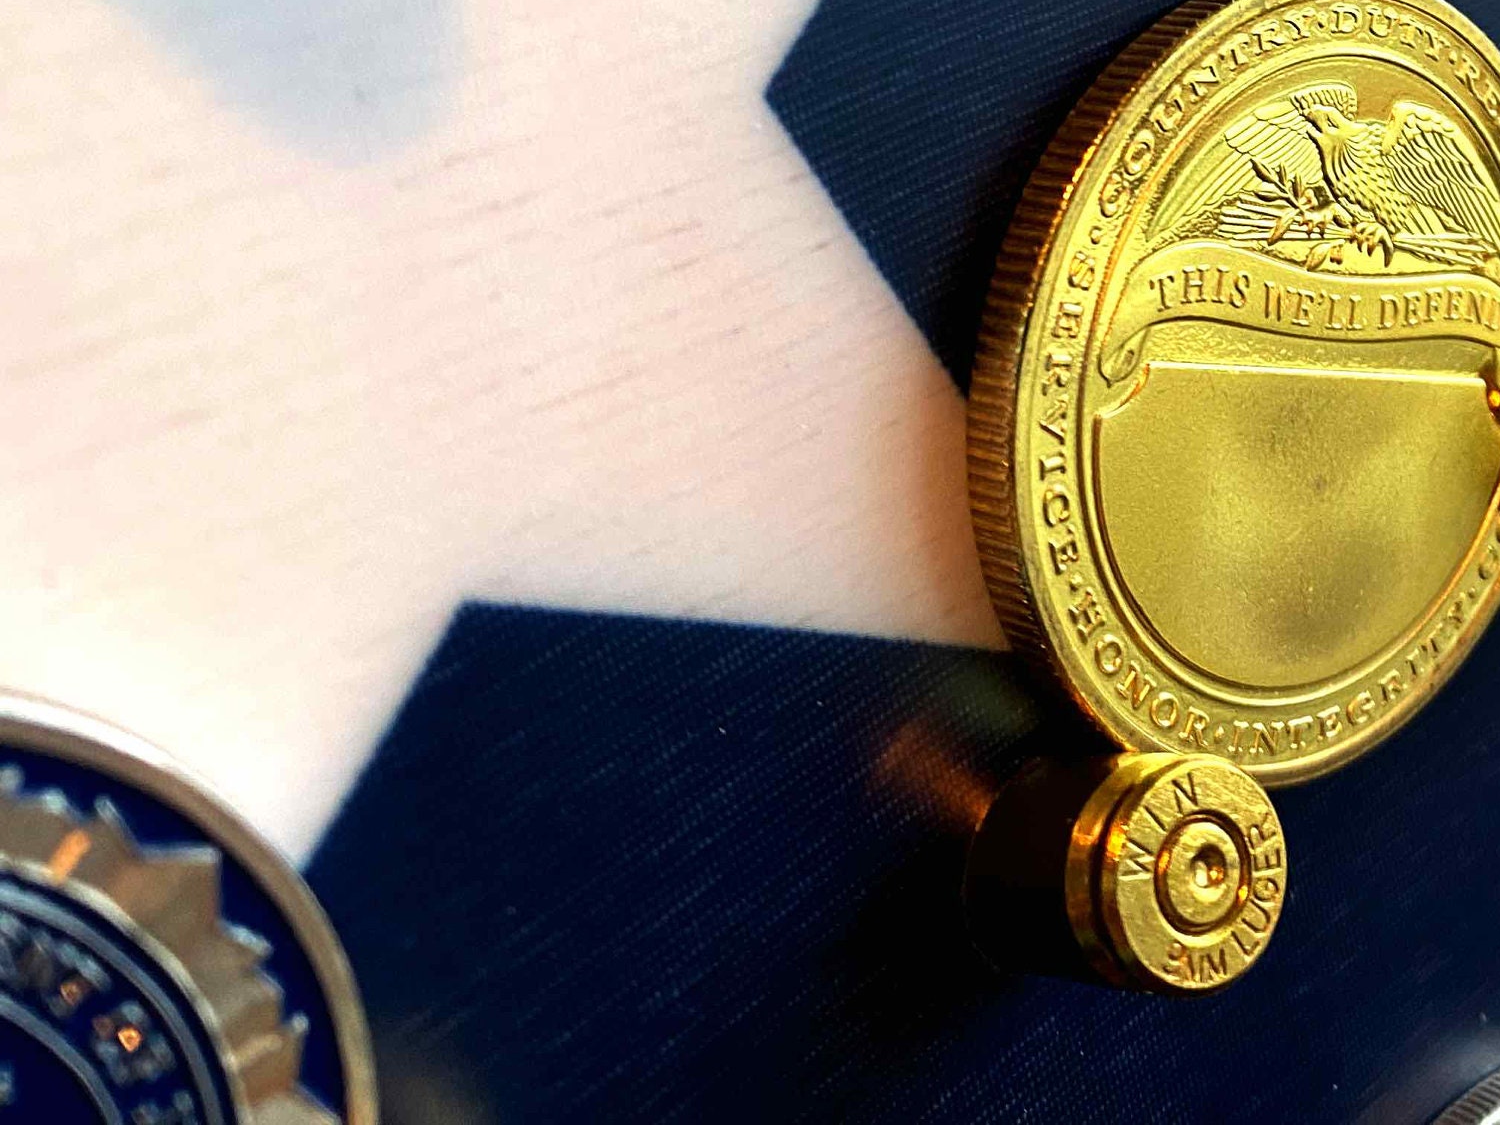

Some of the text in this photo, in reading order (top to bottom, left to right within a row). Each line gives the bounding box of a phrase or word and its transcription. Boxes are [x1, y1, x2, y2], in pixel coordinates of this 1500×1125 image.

[1101, 5, 1312, 221] COUNTRY
[1329, 4, 1449, 61] DUTY
[1149, 267, 1250, 313] THIS
[1264, 279, 1367, 333] WE'LL
[1038, 251, 1096, 577] SERVICE
[1067, 590, 1212, 750] HONOR
[1225, 607, 1472, 757] INTEGRITY
[1119, 771, 1199, 881] WIN
